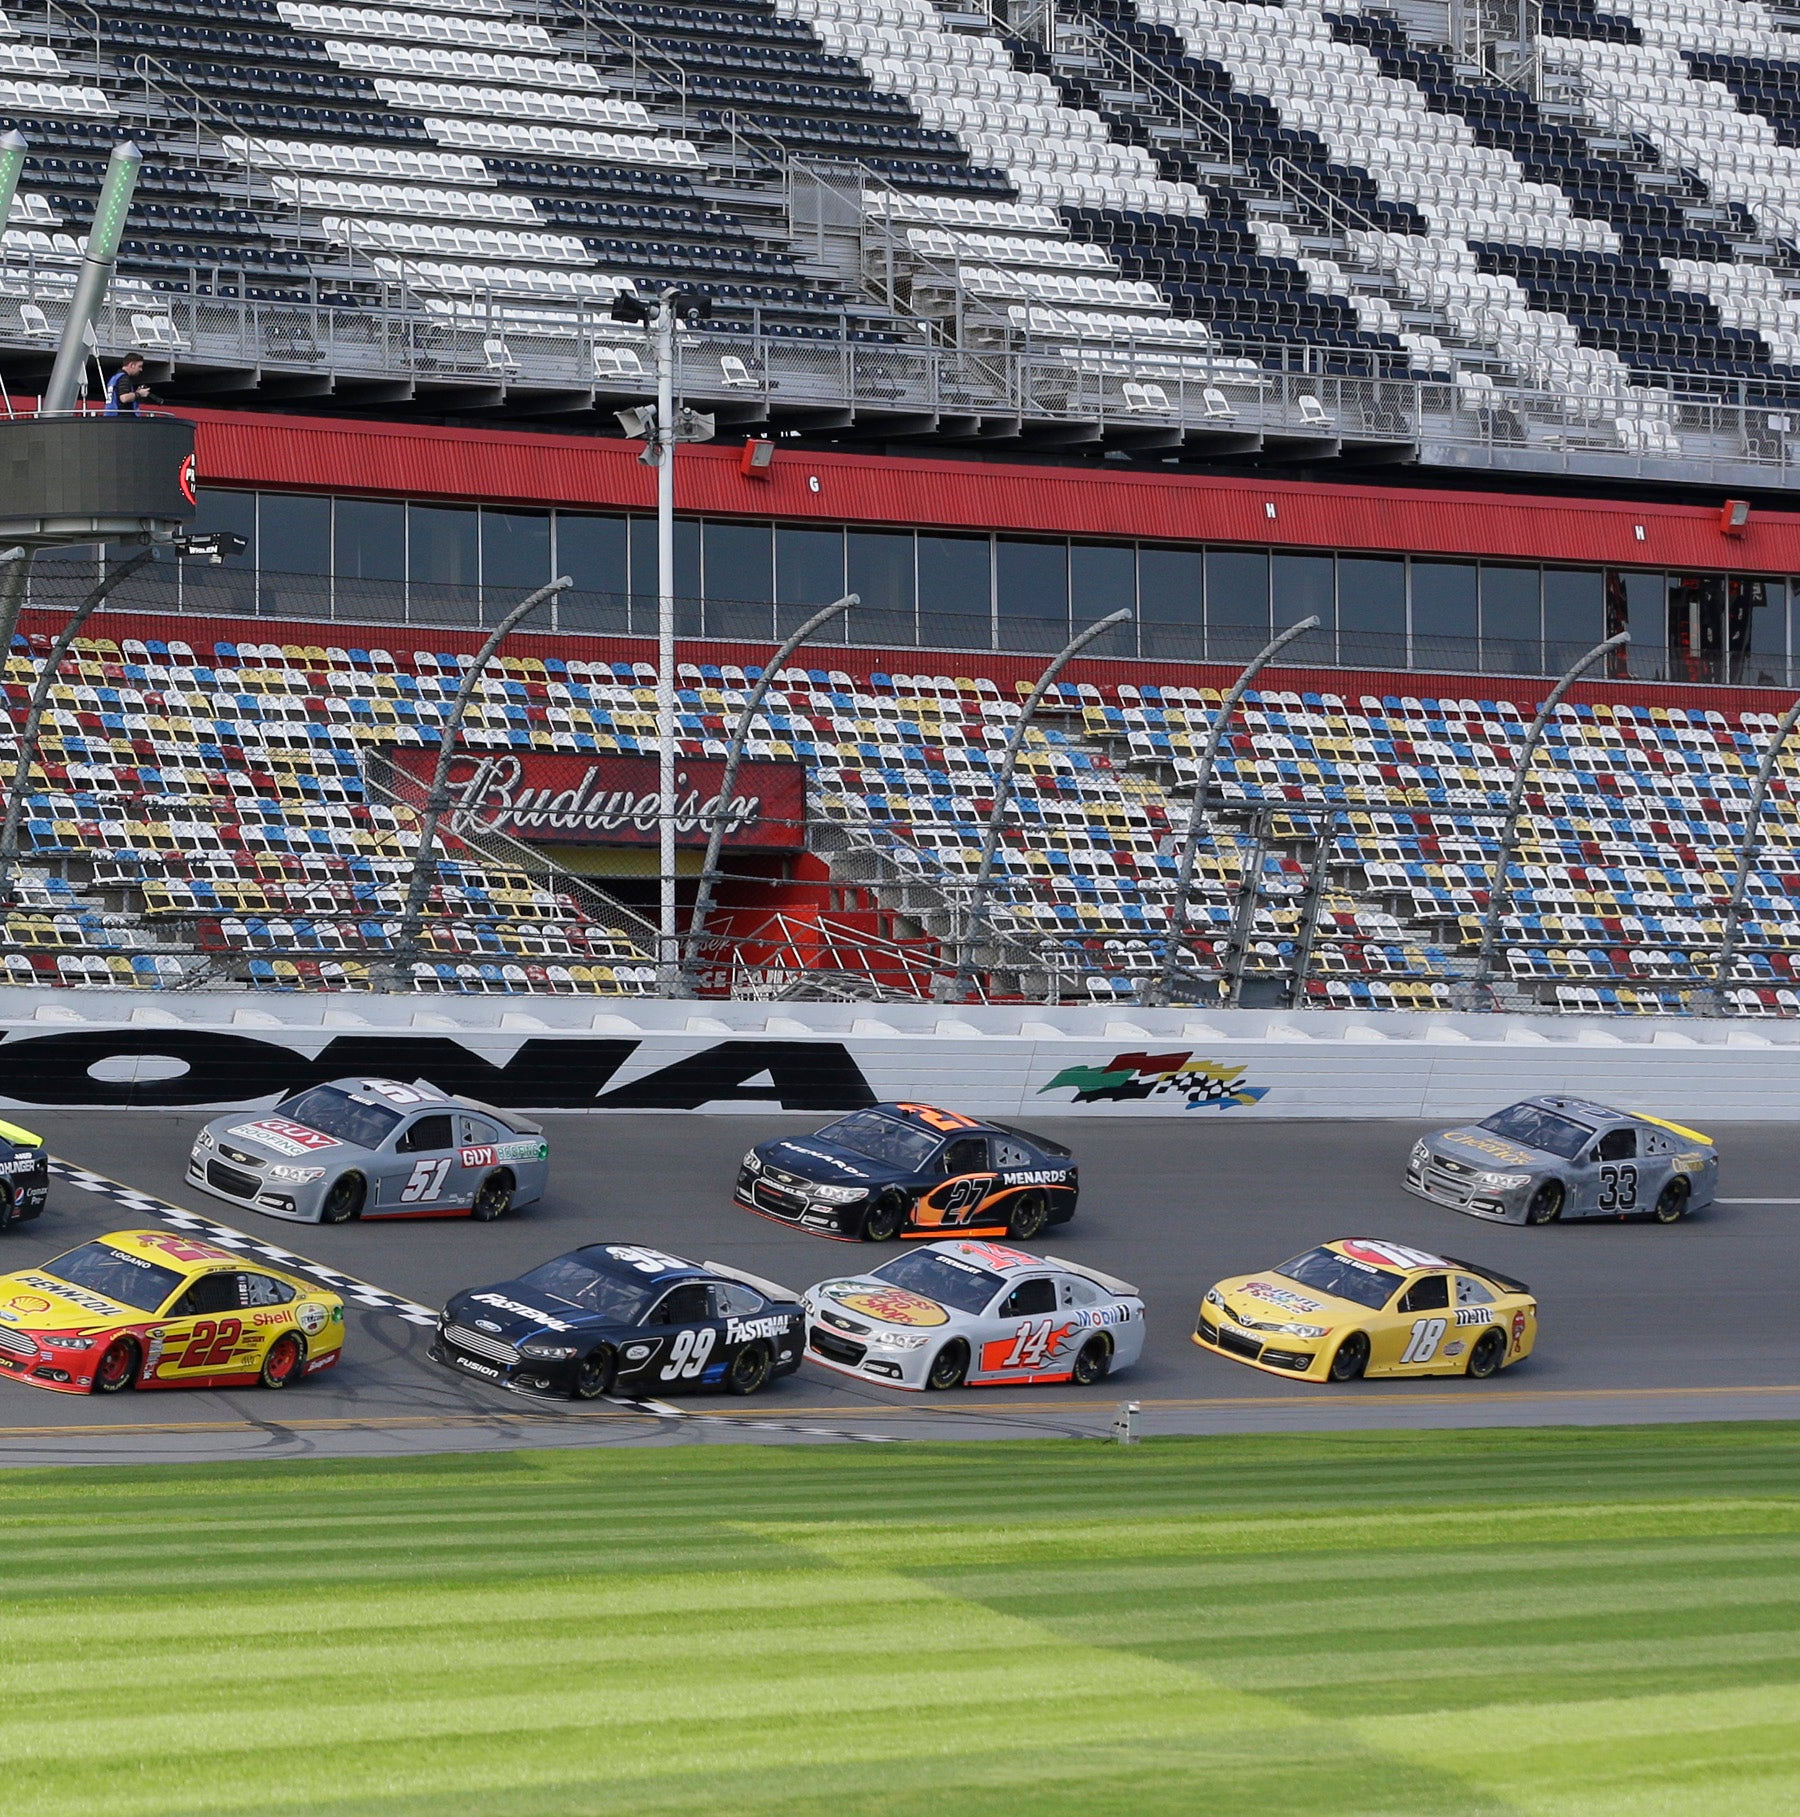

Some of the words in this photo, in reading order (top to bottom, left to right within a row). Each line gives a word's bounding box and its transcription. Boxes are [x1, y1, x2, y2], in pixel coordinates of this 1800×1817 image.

[810, 477, 819, 492] G
[1266, 503, 1275, 518] H
[1635, 526, 1644, 540] H
[234, 1126, 307, 1156] ROOFING
[260, 1121, 329, 1147] GUY
[4, 1160, 35, 1174] HUNGER
[463, 1148, 493, 1167] GUY
[401, 1158, 452, 1203] 51
[1003, 1170, 1067, 1185] MENARDS
[1599, 1163, 1639, 1212] 33
[940, 1178, 994, 1226] 27
[110, 1250, 151, 1269] LOGANO
[935, 1255, 983, 1275] STEWART
[15, 1276, 125, 1316] PENNZOIL
[253, 1310, 293, 1327] Shell
[1075, 1309, 1117, 1327] Mobil
[1118, 1305, 1130, 1323] 1
[725, 1315, 790, 1345] FASTENAL
[1219, 1322, 1268, 1343] CAMRY
[1399, 1318, 1447, 1363] 18
[178, 1318, 242, 1368] 22
[1002, 1319, 1053, 1367] 14
[660, 1328, 716, 1381] 99
[456, 1357, 499, 1378] FUSION
